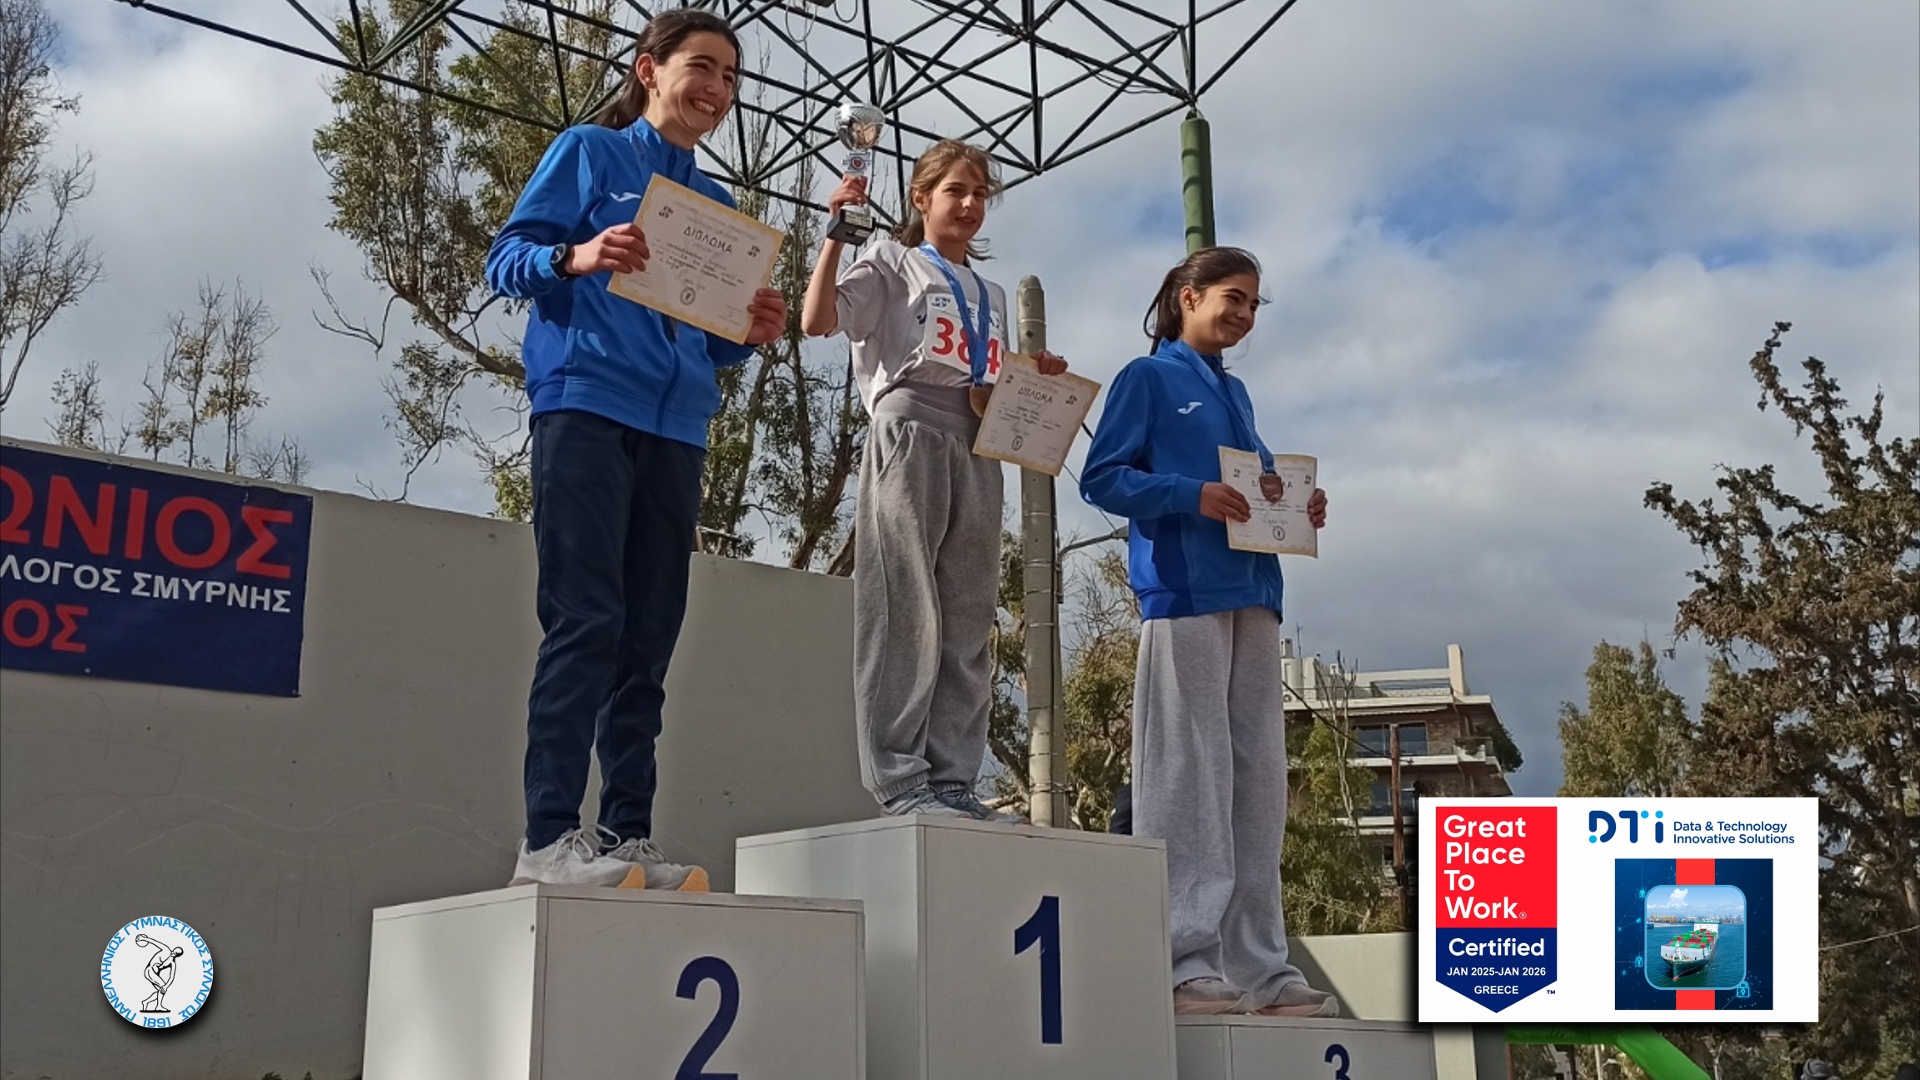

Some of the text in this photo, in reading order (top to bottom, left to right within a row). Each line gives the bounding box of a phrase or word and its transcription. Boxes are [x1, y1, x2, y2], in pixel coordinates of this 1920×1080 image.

[683, 226, 733, 254] ΔΙΠΛΩΜΑ
[0, 554, 291, 613] ΛΟΓΟΣ ΣΜΥΡΝΗΣ
[2, 599, 89, 652] ΟΣ
[1014, 895, 1063, 1044] 1
[674, 956, 740, 1080] 2
[1324, 1044, 1350, 1080] 3
